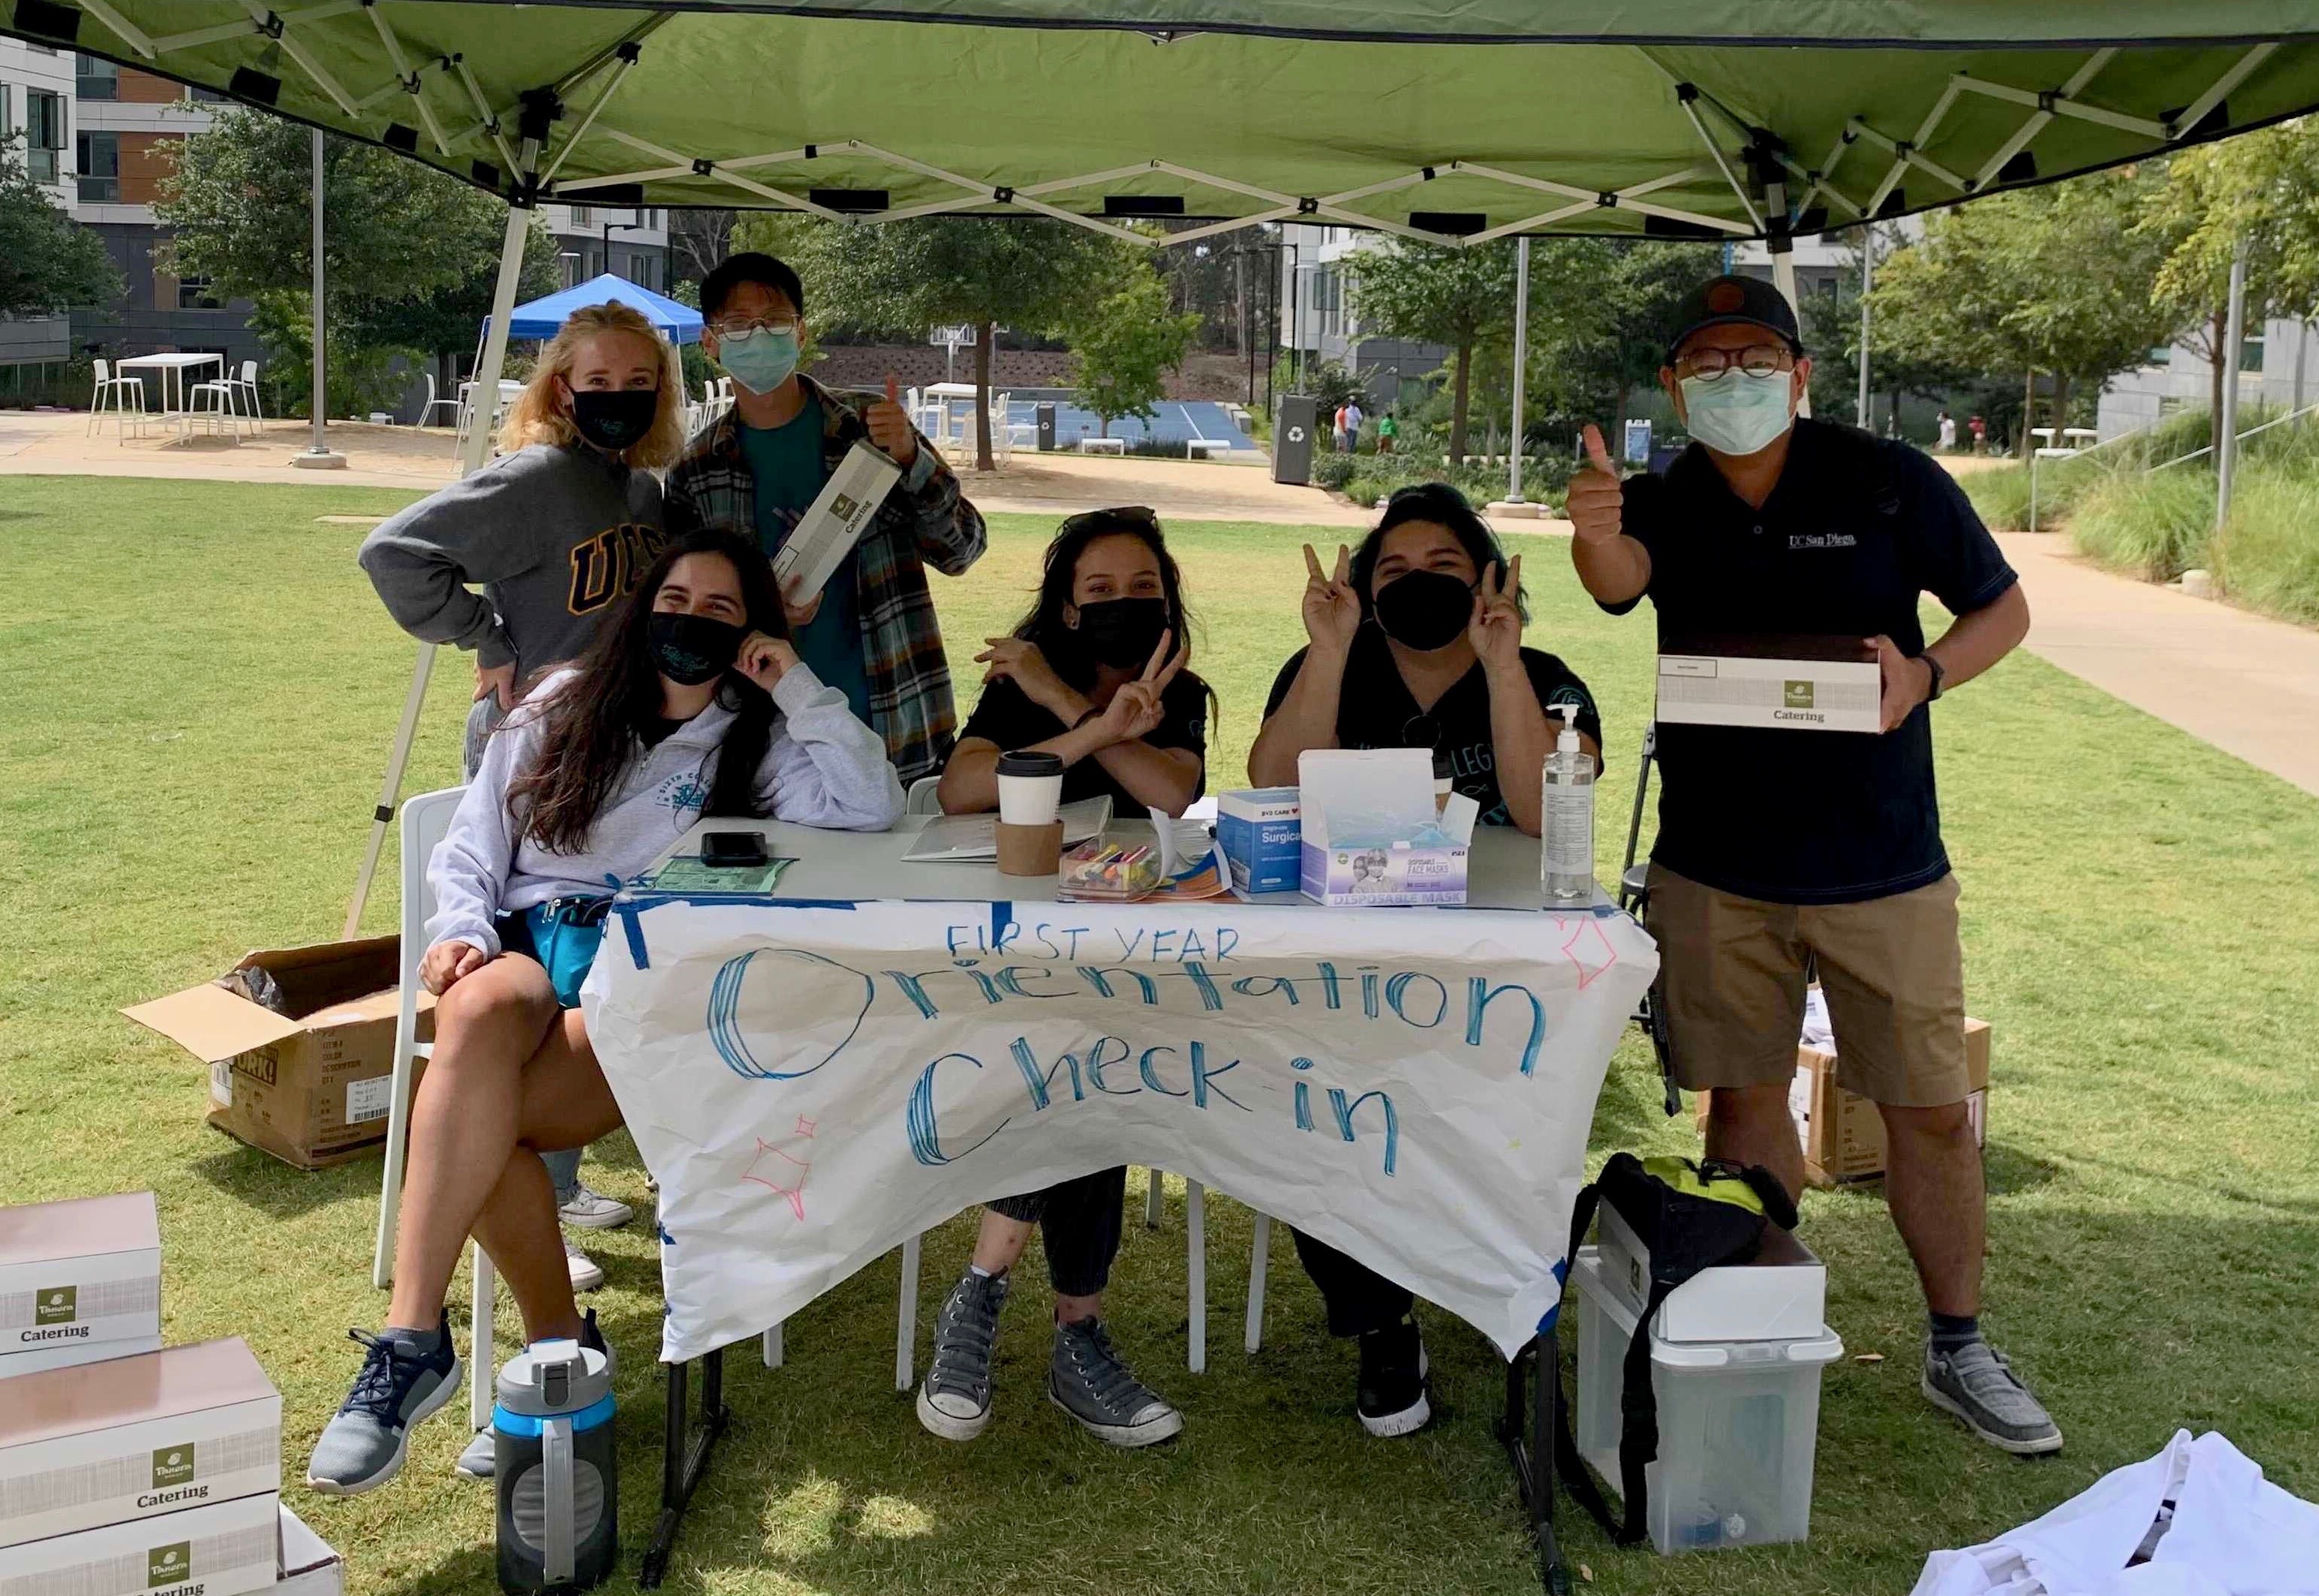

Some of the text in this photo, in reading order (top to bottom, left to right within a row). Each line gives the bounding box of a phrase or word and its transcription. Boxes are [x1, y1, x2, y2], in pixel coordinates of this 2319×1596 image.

[845, 500, 872, 534] Catering
[1805, 534, 1825, 546] San
[1774, 710, 1824, 722] Catering
[1451, 743, 1494, 778] LEG
[1262, 829, 1301, 844] Surgica
[1408, 865, 1449, 874] FACE MASKS
[1334, 892, 1461, 905] DISPOSABLE MASK
[947, 921, 1090, 961] FIRST
[707, 947, 1546, 1081] Orientation
[907, 1036, 1399, 1177] Check in
[21, 1326, 89, 1342] Catering
[137, 1485, 209, 1508] Catering
